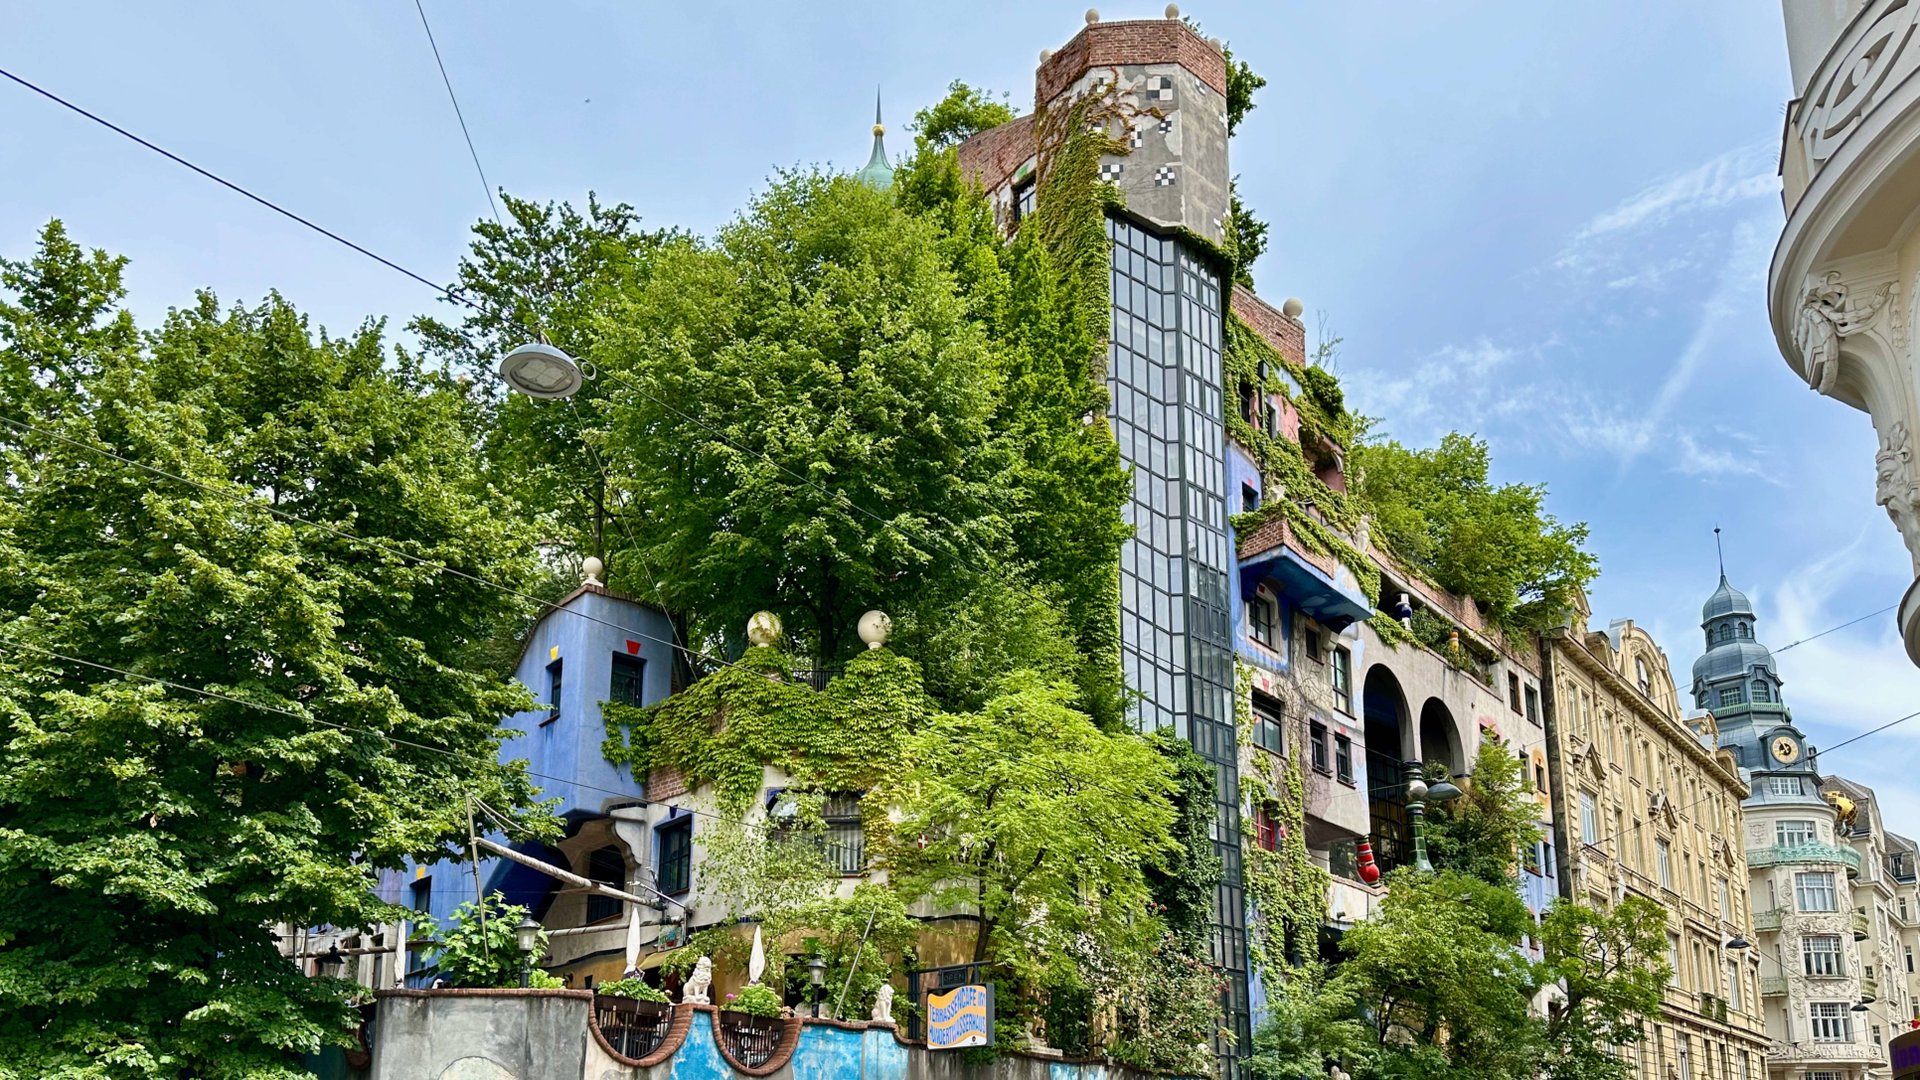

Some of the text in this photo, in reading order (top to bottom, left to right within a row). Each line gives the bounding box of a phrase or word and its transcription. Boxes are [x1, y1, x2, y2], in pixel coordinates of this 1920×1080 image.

[944, 973, 963, 982] OPEN
[929, 987, 986, 1023] TERRASSENCAFE IM
[929, 1013, 986, 1045] HUNDERTWASSERHAUS
